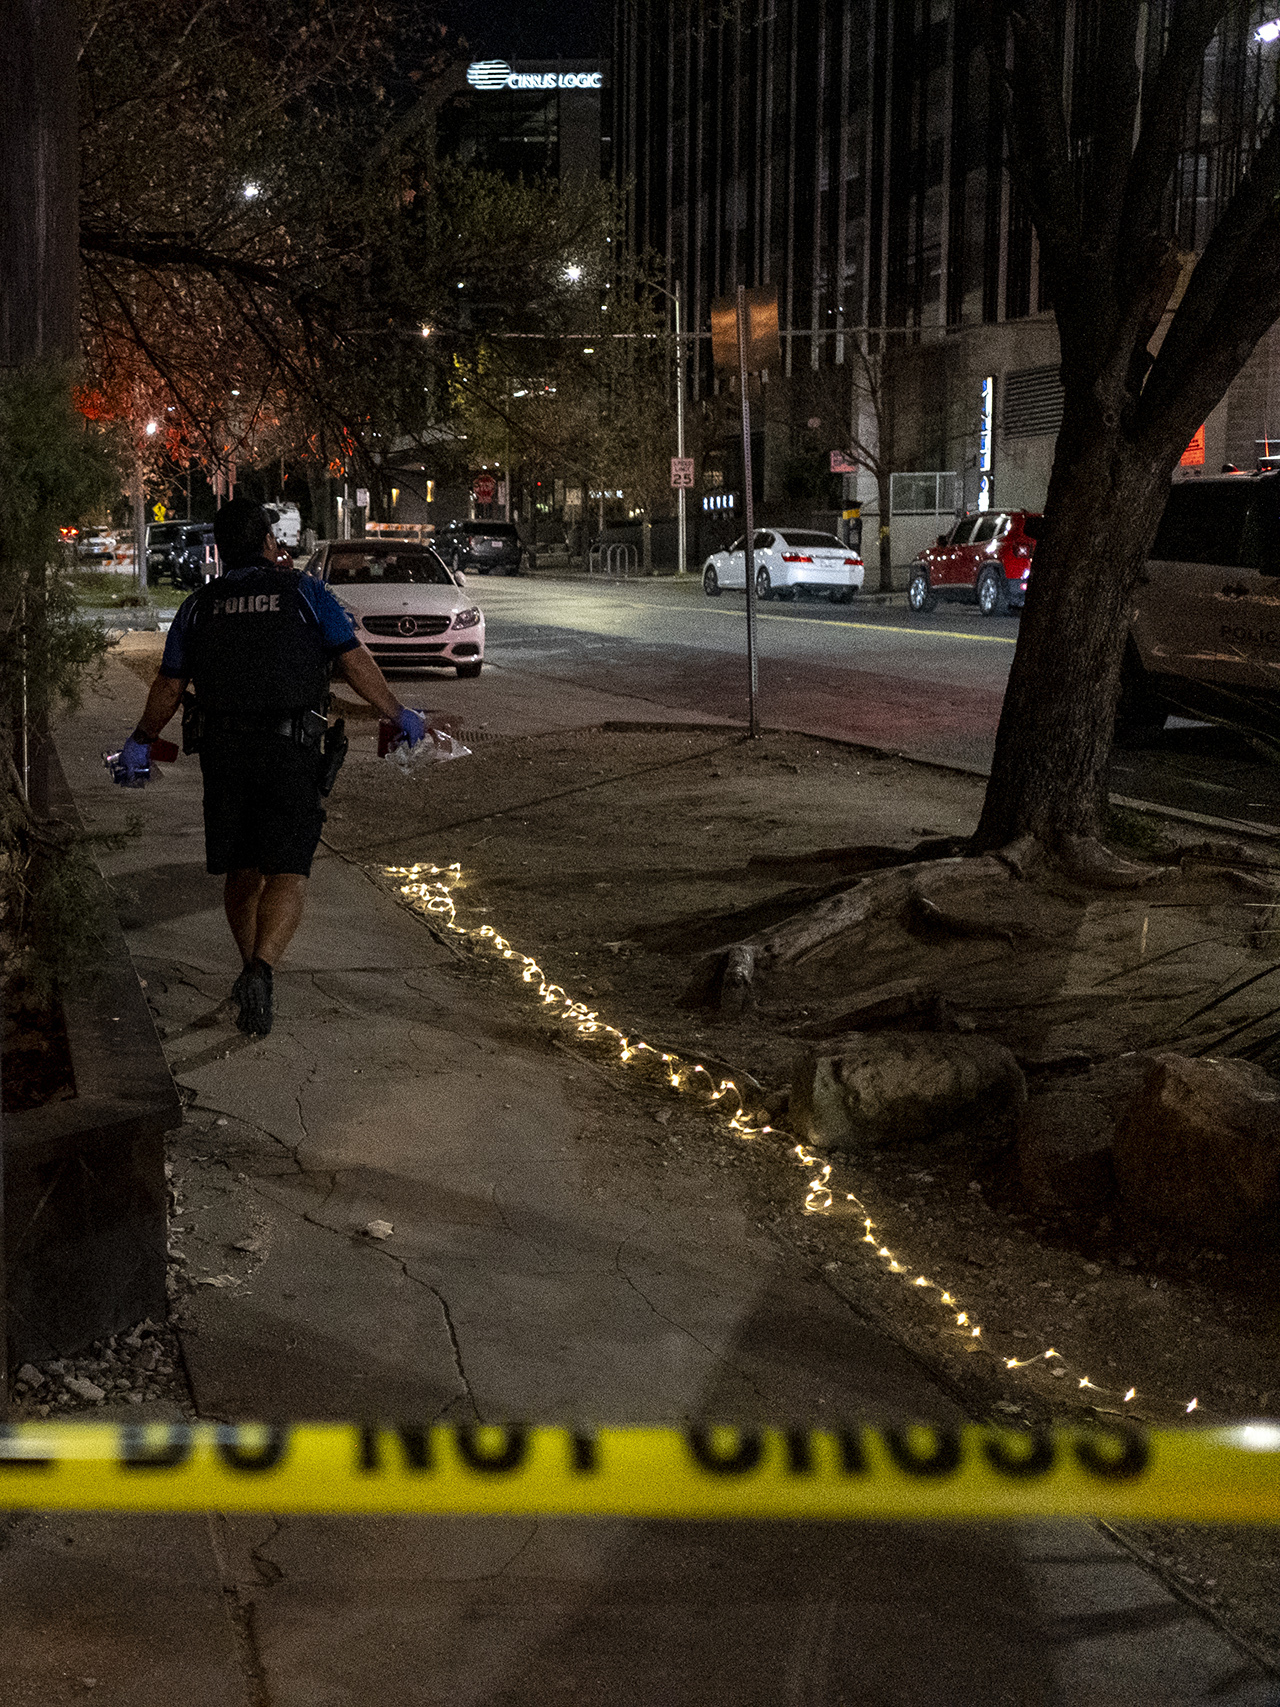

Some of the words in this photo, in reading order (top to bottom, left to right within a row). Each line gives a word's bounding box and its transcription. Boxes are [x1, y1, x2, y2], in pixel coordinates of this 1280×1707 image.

[558, 72, 602, 88] LOGIC
[673, 473, 693, 485] 25
[213, 594, 280, 614] POLICE
[1220, 624, 1280, 643] POLIC
